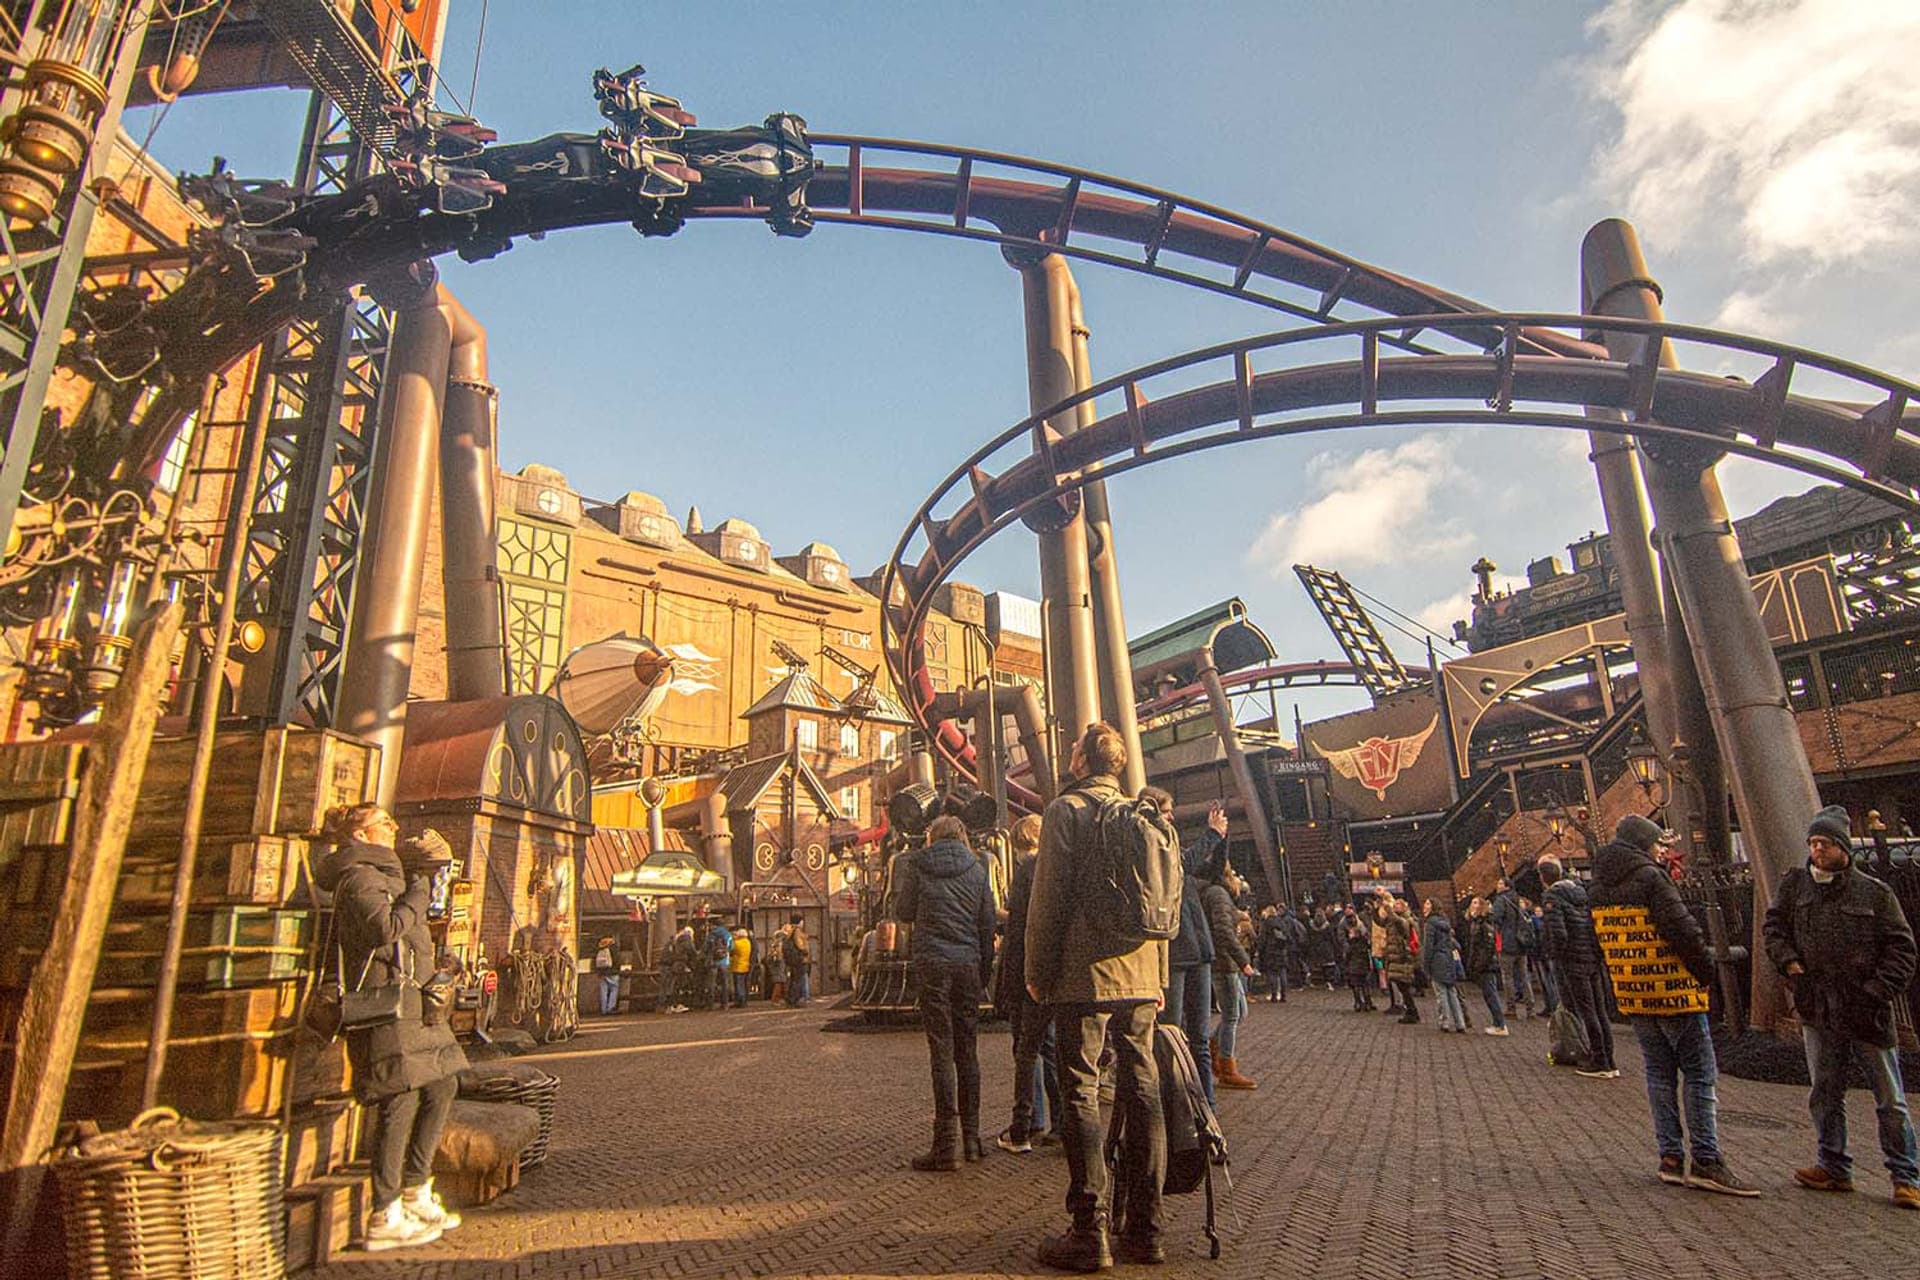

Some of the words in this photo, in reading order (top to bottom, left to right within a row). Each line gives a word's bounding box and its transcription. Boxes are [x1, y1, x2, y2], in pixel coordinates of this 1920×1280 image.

[840, 630, 872, 650] TOR
[1280, 761, 1318, 770] EINGANG
[1626, 931, 1661, 942] BRKLY
[1609, 948, 1647, 959] BRKLYN
[1631, 962, 1679, 975] BRKLYN
[1617, 981, 1656, 992] BRKLYN
[1642, 996, 1690, 1008] BRKLYN
